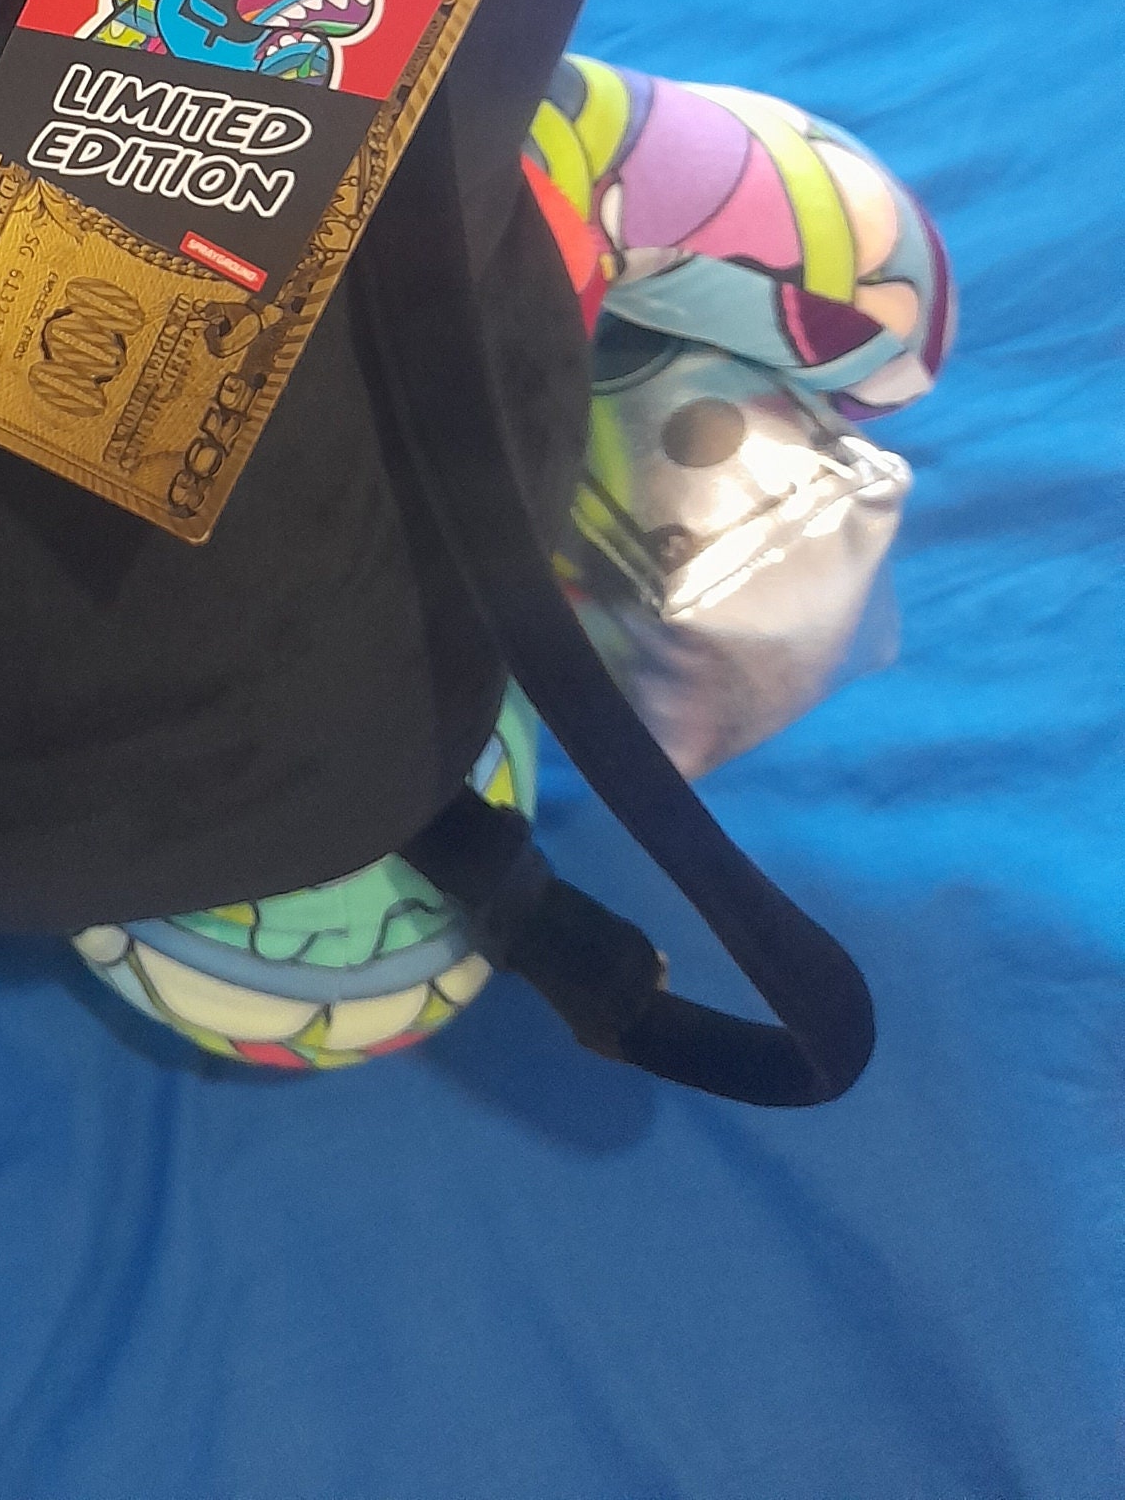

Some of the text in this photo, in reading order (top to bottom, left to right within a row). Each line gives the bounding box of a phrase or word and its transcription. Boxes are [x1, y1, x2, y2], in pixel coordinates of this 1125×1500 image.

[54, 63, 312, 156] LIMITED
[27, 122, 295, 218] EDITION
[18, 233, 39, 259] SG
[186, 237, 257, 283] SPRAYGROUND
